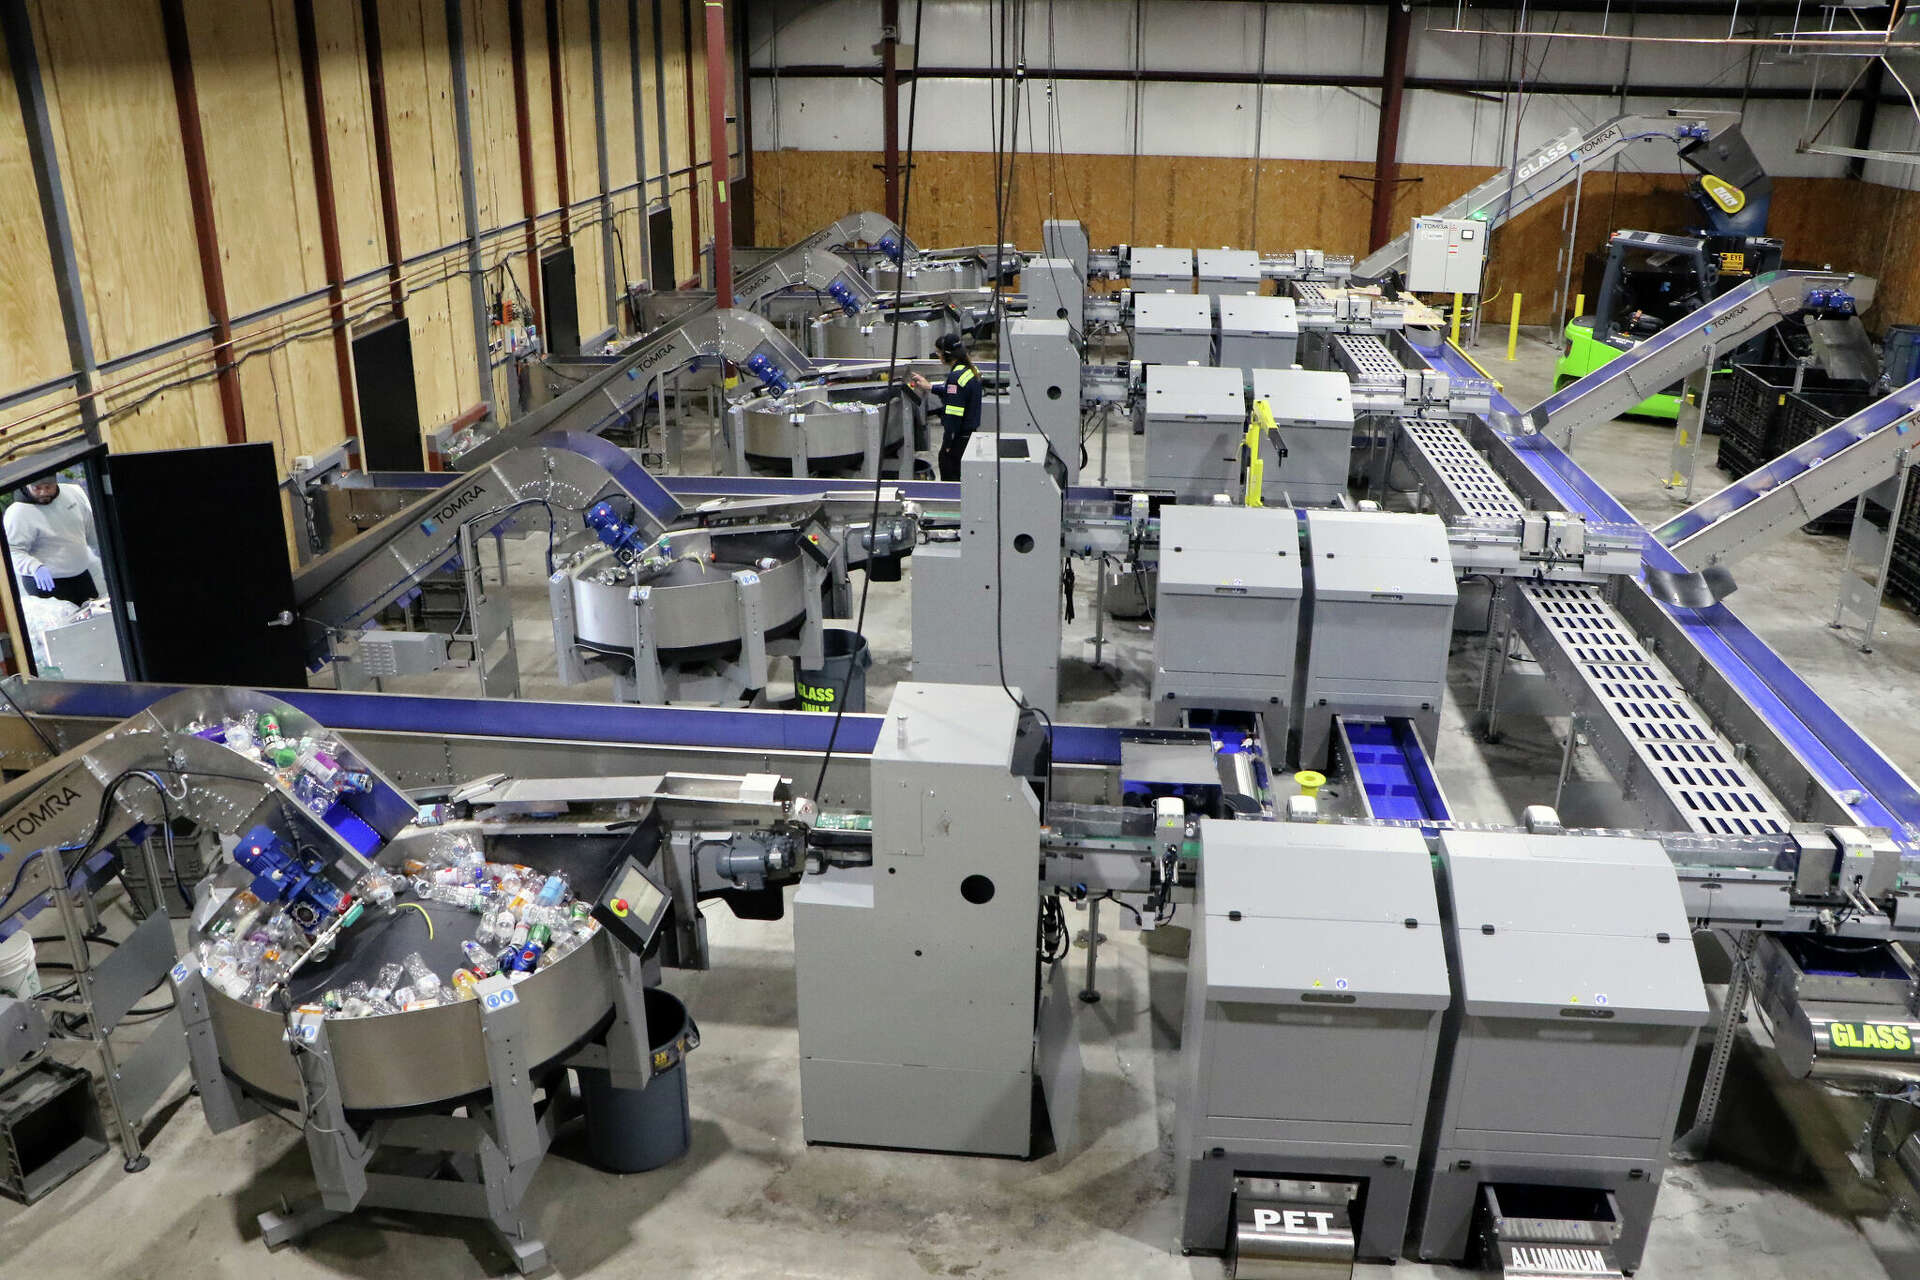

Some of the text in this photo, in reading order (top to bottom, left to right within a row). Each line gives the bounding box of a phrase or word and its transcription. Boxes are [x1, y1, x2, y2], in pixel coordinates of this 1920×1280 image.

[1577, 129, 1616, 155] TOMRA
[1518, 142, 1568, 178] GLASS
[741, 274, 772, 297] TOMRA
[1712, 304, 1749, 329] TOMRA
[637, 343, 676, 373] TOMRA
[433, 485, 487, 524] TOMRA
[3, 786, 82, 842] TOMRA
[1830, 1022, 1911, 1051] GLASS
[1253, 1208, 1334, 1236] PET
[1510, 1246, 1607, 1272] ALUMINUM
